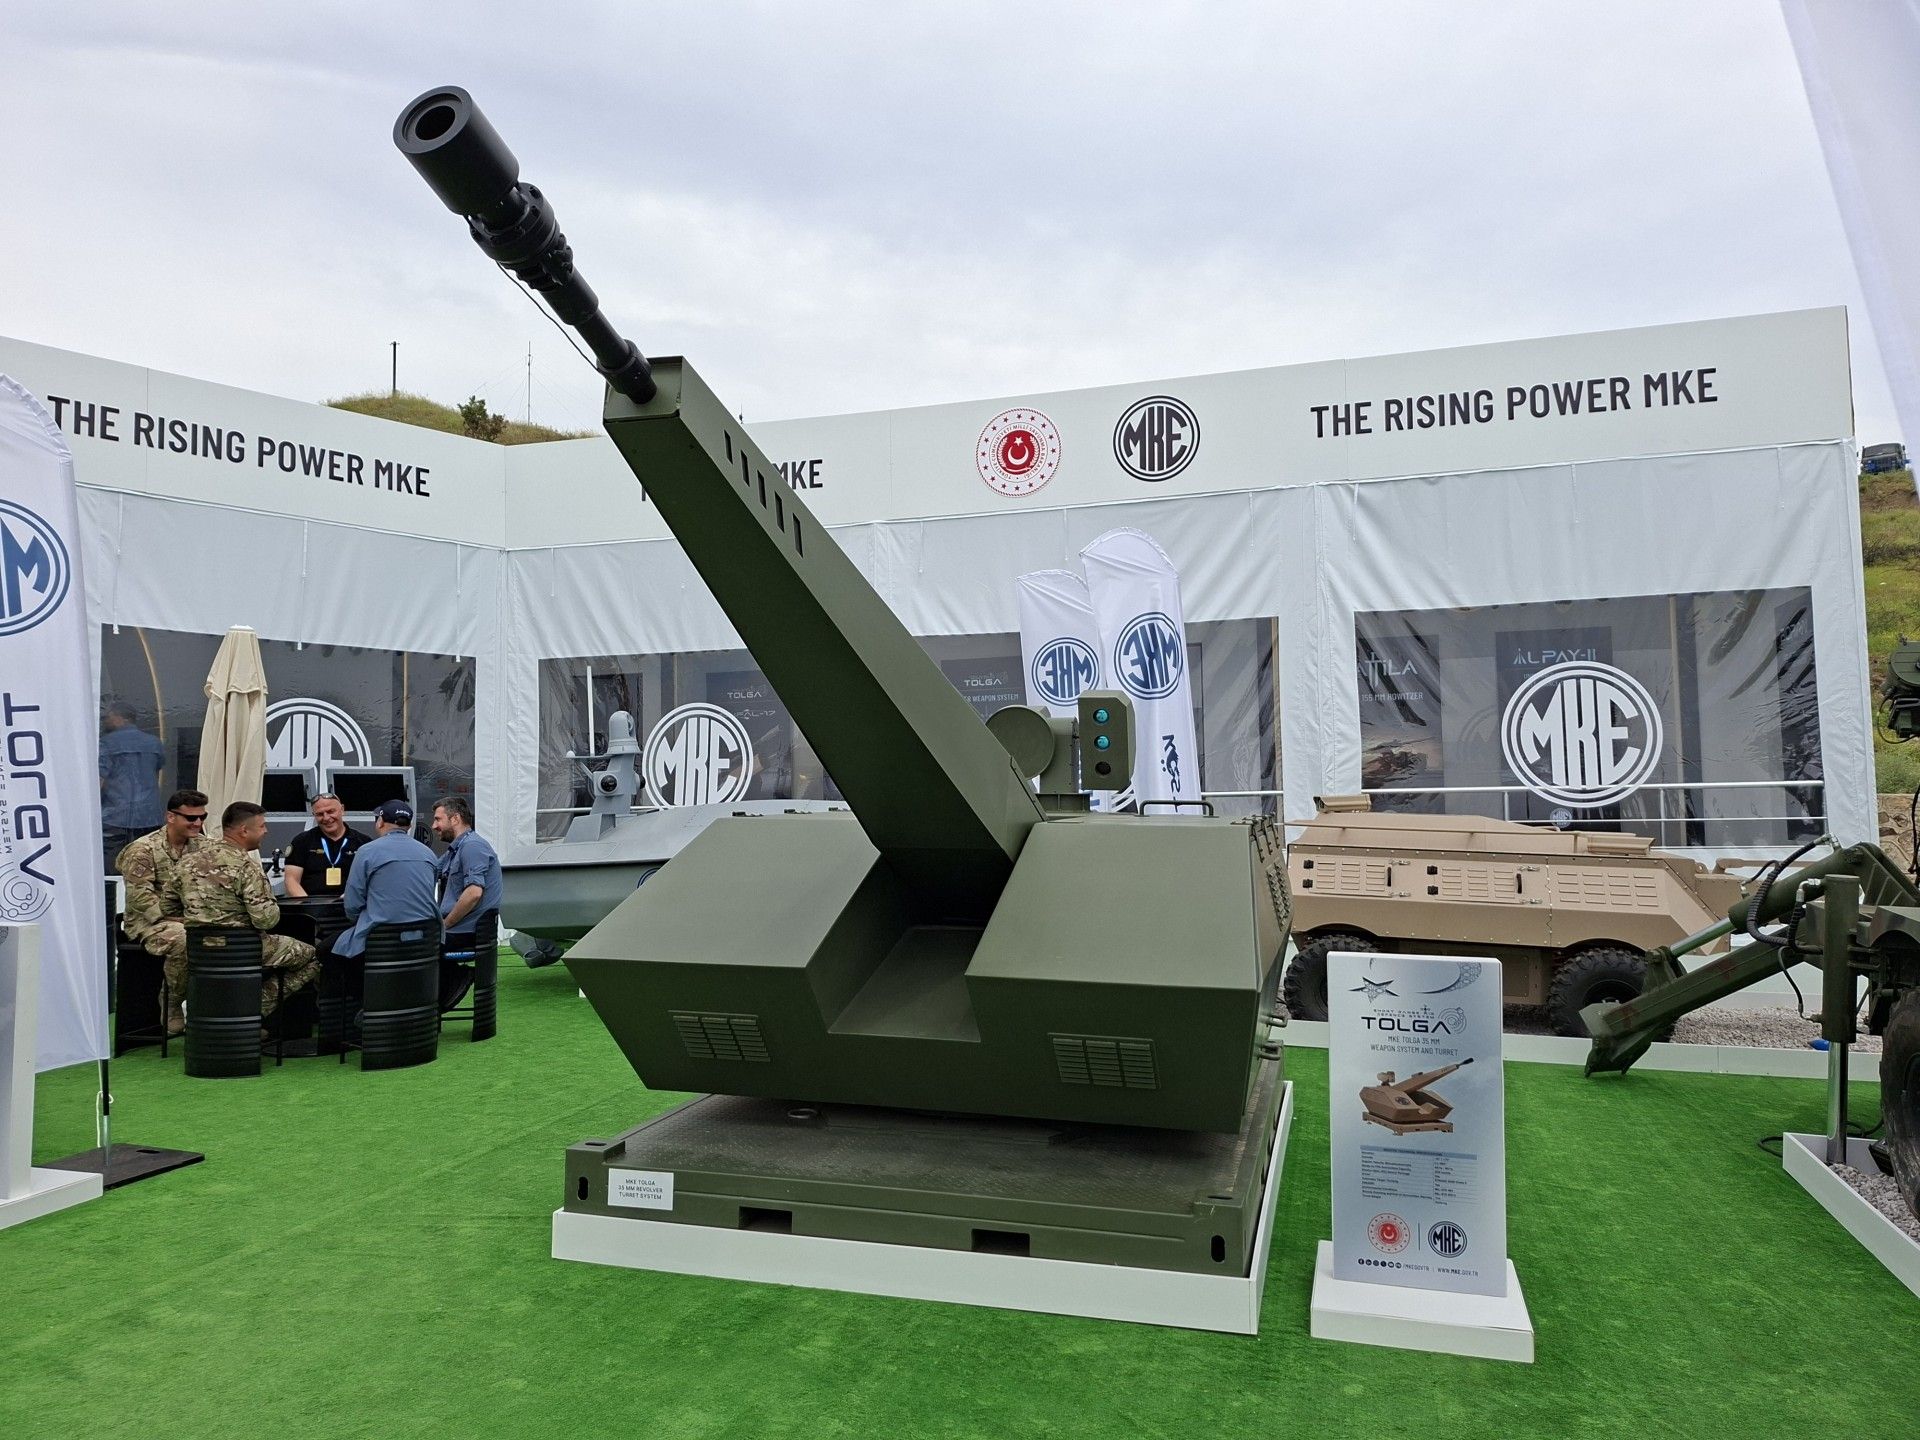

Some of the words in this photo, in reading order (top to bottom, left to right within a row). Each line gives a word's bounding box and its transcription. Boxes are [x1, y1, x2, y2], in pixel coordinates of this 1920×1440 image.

[1310, 401, 1373, 438] THE
[1383, 389, 1494, 432] RISING
[1506, 376, 1631, 420] POWER
[1643, 367, 1718, 408] MKE
[47, 395, 120, 442] THE
[133, 412, 246, 464] RISING
[257, 436, 364, 486] POWER
[374, 458, 431, 497] MKE
[1123, 405, 1188, 472] MKE
[964, 678, 1002, 687] TOLGA
[727, 691, 762, 699] TOLGA
[972, 694, 996, 702] WEAPON
[997, 693, 1019, 701] SYSTEM
[1520, 678, 1641, 790] MKE
[655, 716, 738, 806] MKE
[1361, 1016, 1451, 1035] TOLGA
[1370, 1044, 1396, 1053] WEAPON
[1396, 1045, 1420, 1054] SYSTEM
[1420, 1046, 1434, 1055] AND
[1435, 1047, 1459, 1056] TURRET
[1402, 1036, 1421, 1044] TOLGA
[1422, 1037, 1430, 1045] 35
[1432, 1225, 1462, 1254] MKE
